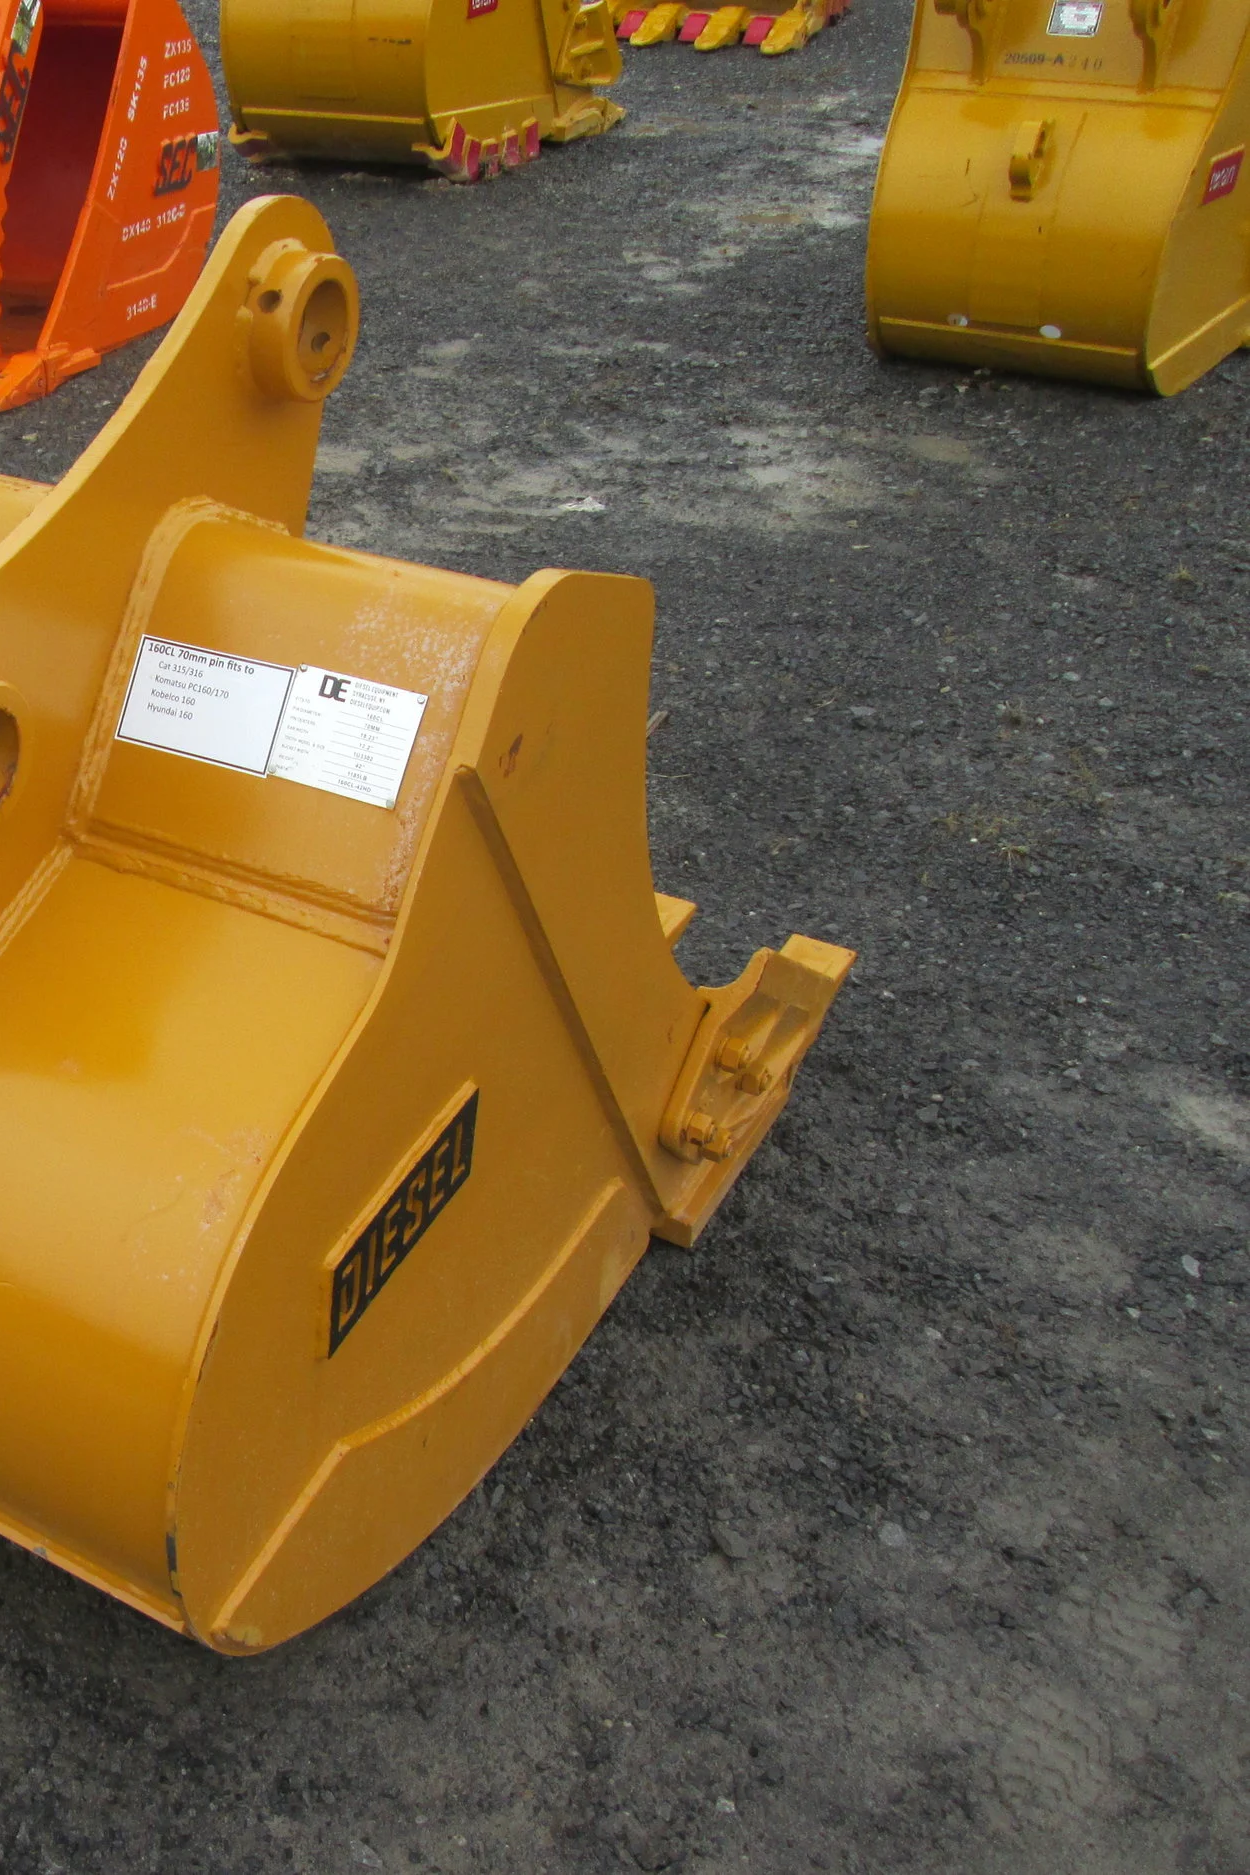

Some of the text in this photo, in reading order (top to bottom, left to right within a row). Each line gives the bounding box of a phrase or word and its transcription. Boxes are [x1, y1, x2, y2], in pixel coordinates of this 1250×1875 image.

[164, 38, 192, 58] ZX135
[127, 55, 148, 122] SK135
[148, 642, 255, 675] 160CL 70mm pin fits to
[158, 660, 203, 678] Cat 315/316
[150, 688, 196, 706] Kobelco 160
[154, 674, 229, 699] Komatsu PC160/170
[318, 674, 351, 703] DE
[147, 702, 193, 721] Hyundai 160
[338, 1120, 466, 1332] DIESEL
